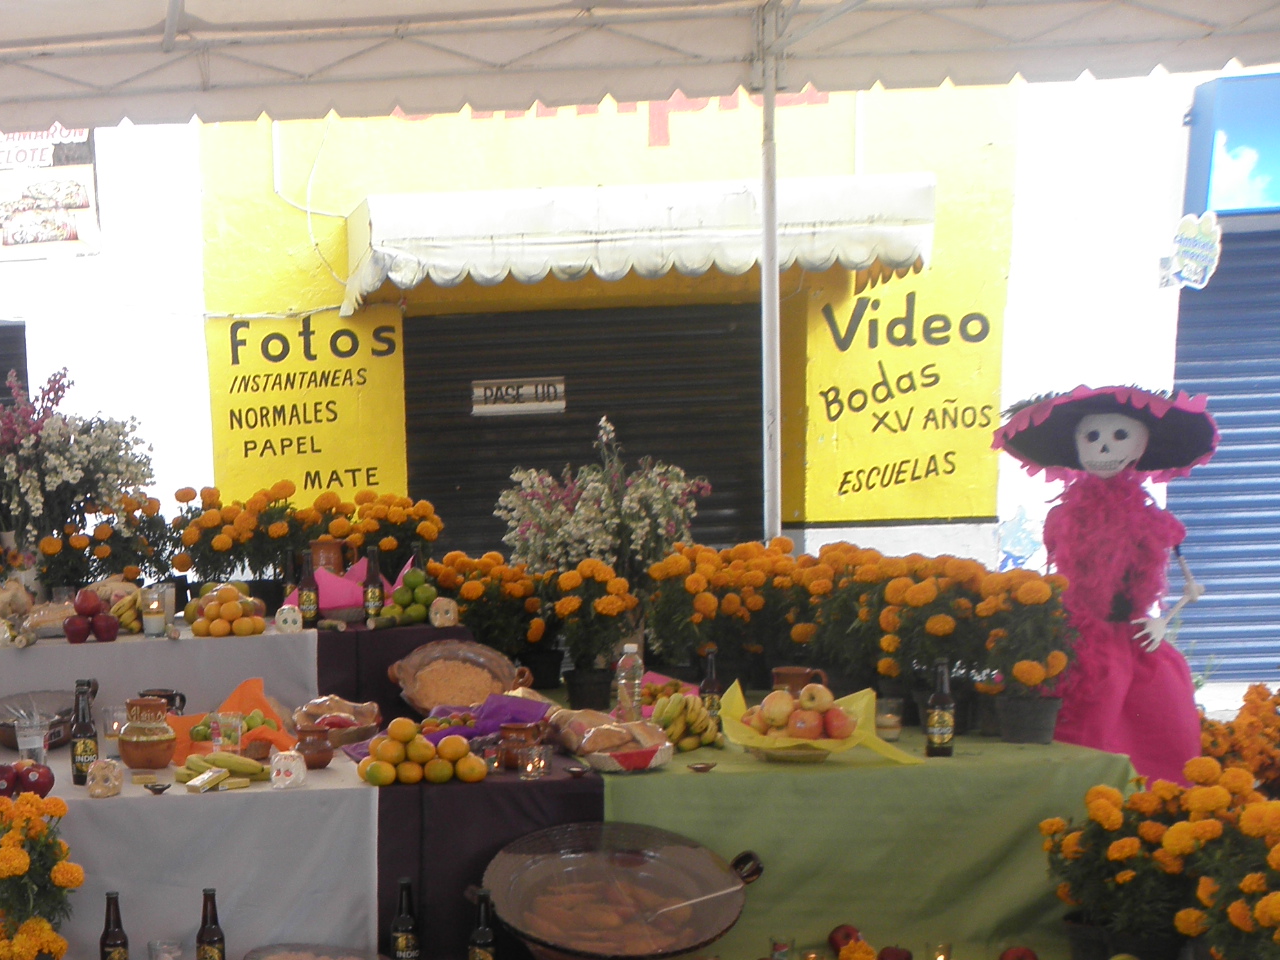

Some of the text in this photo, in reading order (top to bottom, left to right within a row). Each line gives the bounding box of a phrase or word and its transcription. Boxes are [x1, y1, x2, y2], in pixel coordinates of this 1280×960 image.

[821, 291, 991, 353] Video
[229, 368, 368, 395] INSTANTANEAS
[484, 383, 558, 405] PASE UD
[819, 360, 941, 423] Bodas
[229, 400, 339, 431] NORMALES
[872, 398, 994, 434] XV AÑOS
[243, 436, 323, 458] PAPEL
[303, 467, 380, 491] MATE
[838, 450, 957, 497] ESCUELAS
[75, 754, 97, 763] INDIO
[396, 950, 419, 958] INDIO
